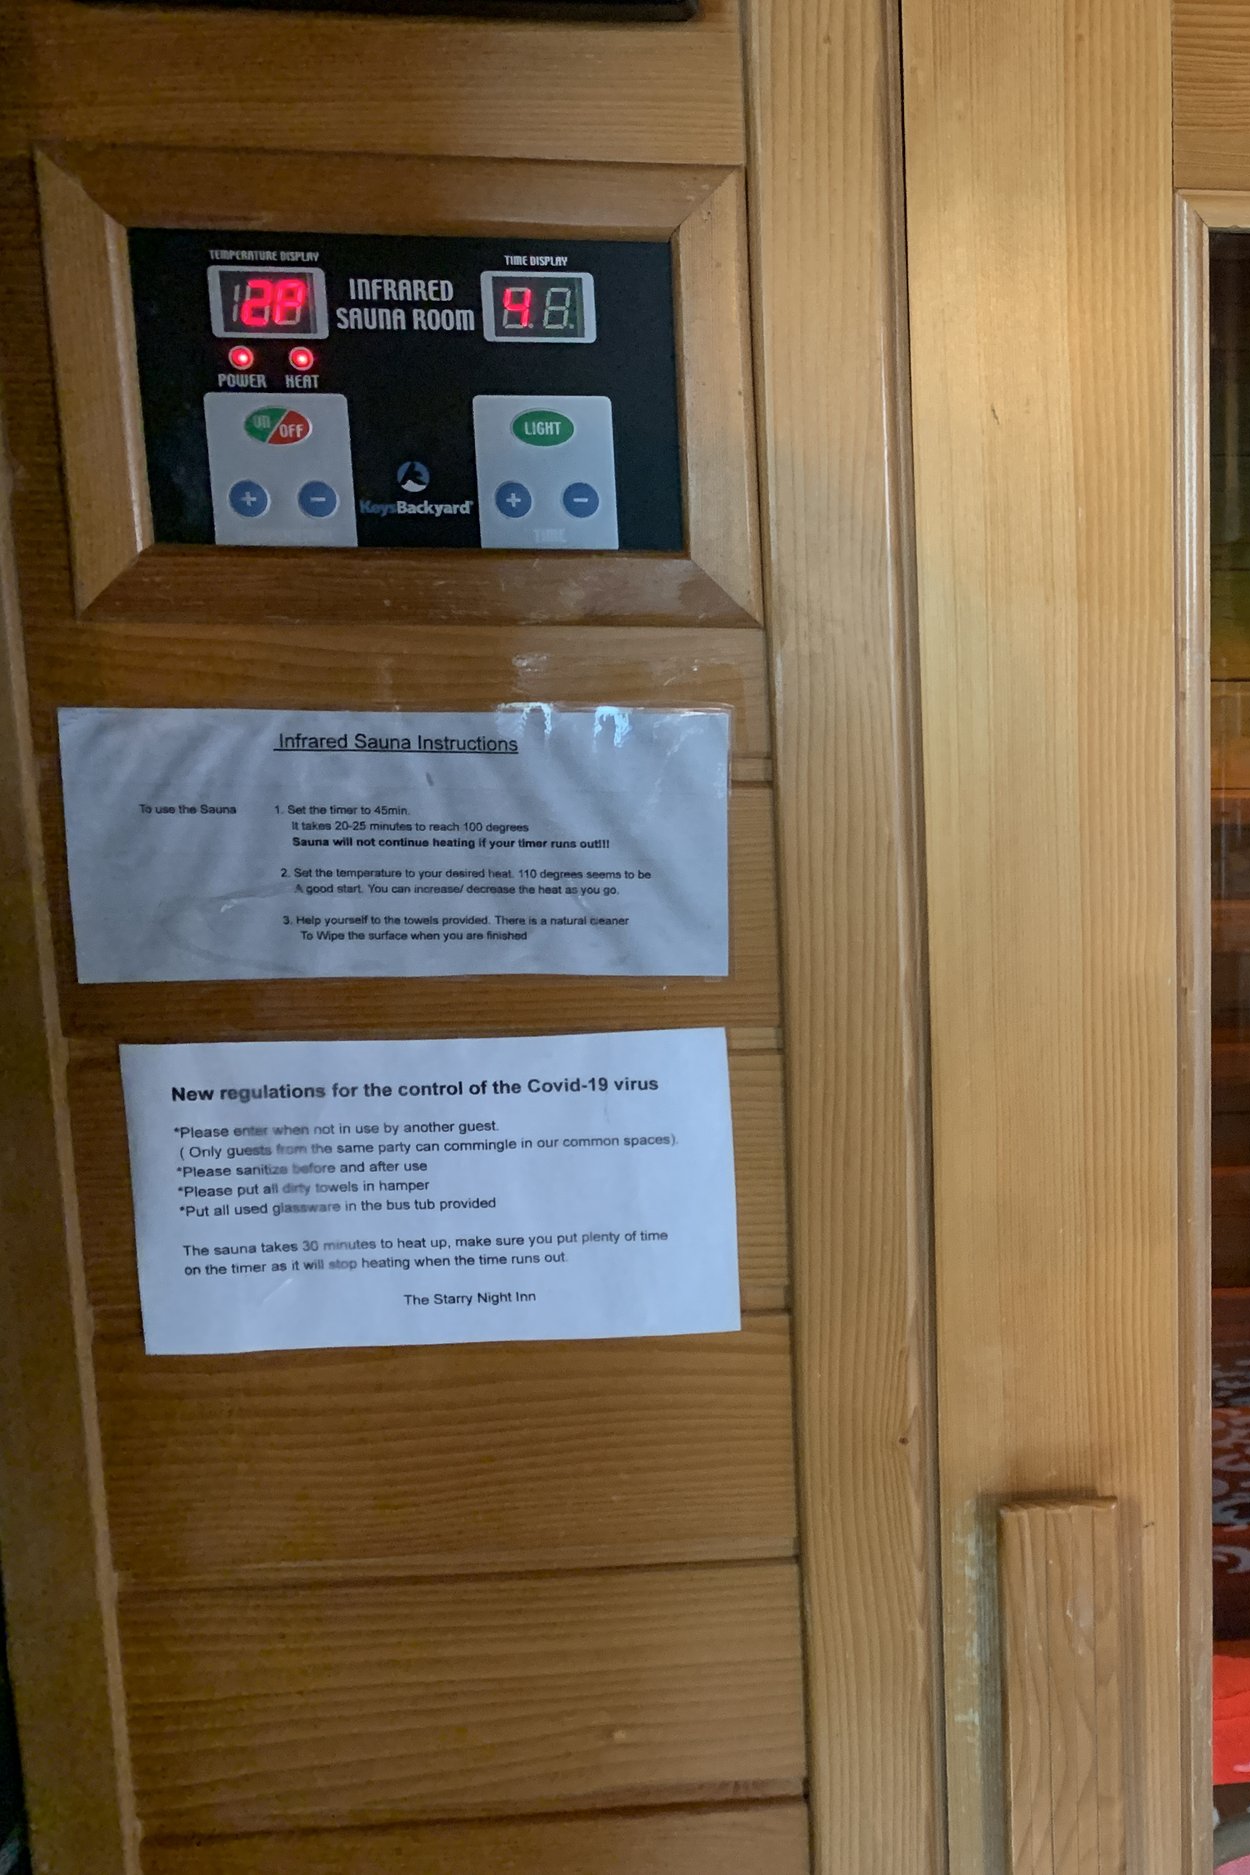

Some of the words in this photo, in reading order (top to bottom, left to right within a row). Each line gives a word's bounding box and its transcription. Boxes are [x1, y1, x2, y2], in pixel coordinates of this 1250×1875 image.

[280, 251, 320, 262] DISPLAY
[504, 255, 528, 266] TIME
[530, 255, 568, 267] DISPLAY
[349, 278, 454, 302] INFRARED
[336, 307, 406, 331] SAUNA
[413, 309, 475, 331] ROOM
[218, 373, 267, 388] POWER
[285, 374, 320, 389] HEAT
[279, 424, 304, 438] OFF
[524, 421, 562, 436] LIGHT
[279, 733, 348, 749] Infrared
[354, 733, 411, 750] Sauna
[417, 734, 519, 750] Instructions
[139, 804, 153, 815] To
[155, 806, 176, 815] use
[178, 804, 197, 815] the
[199, 804, 237, 815] Sauna
[287, 805, 307, 815] Set
[308, 805, 327, 815] the
[329, 805, 358, 816] timer
[360, 805, 372, 816] to
[301, 821, 333, 831] takes
[335, 821, 366, 832] 20-25
[369, 821, 413, 832] minutes
[415, 821, 426, 832] to
[429, 821, 460, 832] reach
[463, 821, 483, 832] 100
[485, 821, 529, 835] degrees
[291, 837, 330, 847] Sauna
[332, 837, 355, 848] will
[356, 837, 376, 848] not
[377, 837, 429, 848] continue
[432, 837, 476, 851] heating
[489, 840, 515, 851] your
[518, 838, 547, 848] timer
[550, 840, 577, 849] runs
[294, 867, 313, 878] Set
[314, 868, 335, 878] the
[336, 868, 402, 881] temperature
[405, 868, 416, 879] to
[418, 870, 442, 881] your
[445, 868, 485, 879] desired
[518, 868, 537, 879] 110
[539, 868, 583, 882] degrees
[586, 871, 622, 879] seems
[624, 869, 635, 879] to
[637, 869, 651, 879] be
[305, 883, 334, 897] good
[368, 884, 389, 894] You
[391, 886, 411, 894] can
[466, 884, 515, 895] decrease
[518, 884, 535, 895] the
[537, 884, 562, 895] heat
[580, 886, 600, 897] you
[296, 915, 321, 928] Help
[323, 915, 368, 928] yourself
[370, 915, 382, 926] to
[384, 915, 402, 926] the
[403, 915, 439, 926] towels
[494, 915, 525, 926] There
[550, 915, 587, 926] natural
[300, 930, 314, 941] To
[316, 930, 345, 943] Wipe
[348, 930, 367, 941] the
[368, 930, 408, 941] surface
[410, 930, 440, 941] when
[443, 932, 464, 943] you
[465, 932, 484, 940] are
[486, 930, 527, 940] finished
[171, 1085, 214, 1102] New
[219, 1083, 326, 1105] regulations
[332, 1082, 359, 1098] for
[363, 1081, 392, 1097] the
[398, 1079, 463, 1097] control
[469, 1079, 488, 1095] of
[492, 1078, 522, 1094] the
[527, 1076, 608, 1094] Covid-19
[614, 1075, 659, 1092] virus
[273, 1123, 310, 1136] when
[313, 1123, 335, 1135] not
[338, 1123, 351, 1135] in
[355, 1125, 381, 1135] use
[383, 1122, 402, 1138] by
[403, 1121, 455, 1134] another
[188, 1145, 222, 1161] Only
[226, 1143, 273, 1160] guests
[310, 1142, 333, 1155] the
[336, 1144, 374, 1154] same
[378, 1140, 413, 1156] party
[415, 1142, 440, 1152] can
[444, 1137, 519, 1155] commingle
[521, 1137, 533, 1149] in
[536, 1139, 559, 1149] our
[562, 1138, 620, 1148] common
[339, 1160, 365, 1173] and
[369, 1159, 401, 1172] after
[404, 1162, 428, 1172] use
[237, 1183, 260, 1199] put
[263, 1183, 280, 1195] all
[315, 1180, 359, 1194] towels
[363, 1180, 375, 1192] in
[379, 1178, 430, 1195] hamper
[213, 1203, 230, 1216] all
[234, 1202, 269, 1215] used
[345, 1200, 357, 1212] in
[361, 1199, 382, 1212] the
[386, 1198, 411, 1211] bus
[414, 1198, 435, 1210] tub
[439, 1196, 496, 1213] provided
[182, 1244, 210, 1256] The
[214, 1245, 257, 1255] sauna
[261, 1241, 298, 1254] takes
[323, 1238, 377, 1252] minutes
[380, 1238, 393, 1250] to
[397, 1236, 427, 1249] heat
[430, 1238, 451, 1252] up,
[455, 1234, 492, 1247] make
[495, 1236, 525, 1246] sure
[528, 1235, 552, 1248] you
[557, 1232, 578, 1247] put
[582, 1230, 620, 1247] plenty
[624, 1230, 637, 1242] of
[638, 1229, 668, 1242] time
[184, 1266, 201, 1276] on
[204, 1263, 228, 1275] the
[231, 1261, 267, 1274] timer
[271, 1263, 287, 1273] as
[302, 1259, 325, 1272] will
[361, 1256, 410, 1273] heating
[414, 1255, 451, 1268] when
[454, 1254, 477, 1266] the
[478, 1253, 508, 1266] time
[511, 1254, 541, 1264] runs
[403, 1293, 431, 1305] The
[433, 1292, 473, 1308] Starry
[477, 1291, 513, 1307] Night
[515, 1290, 536, 1302] Inn
